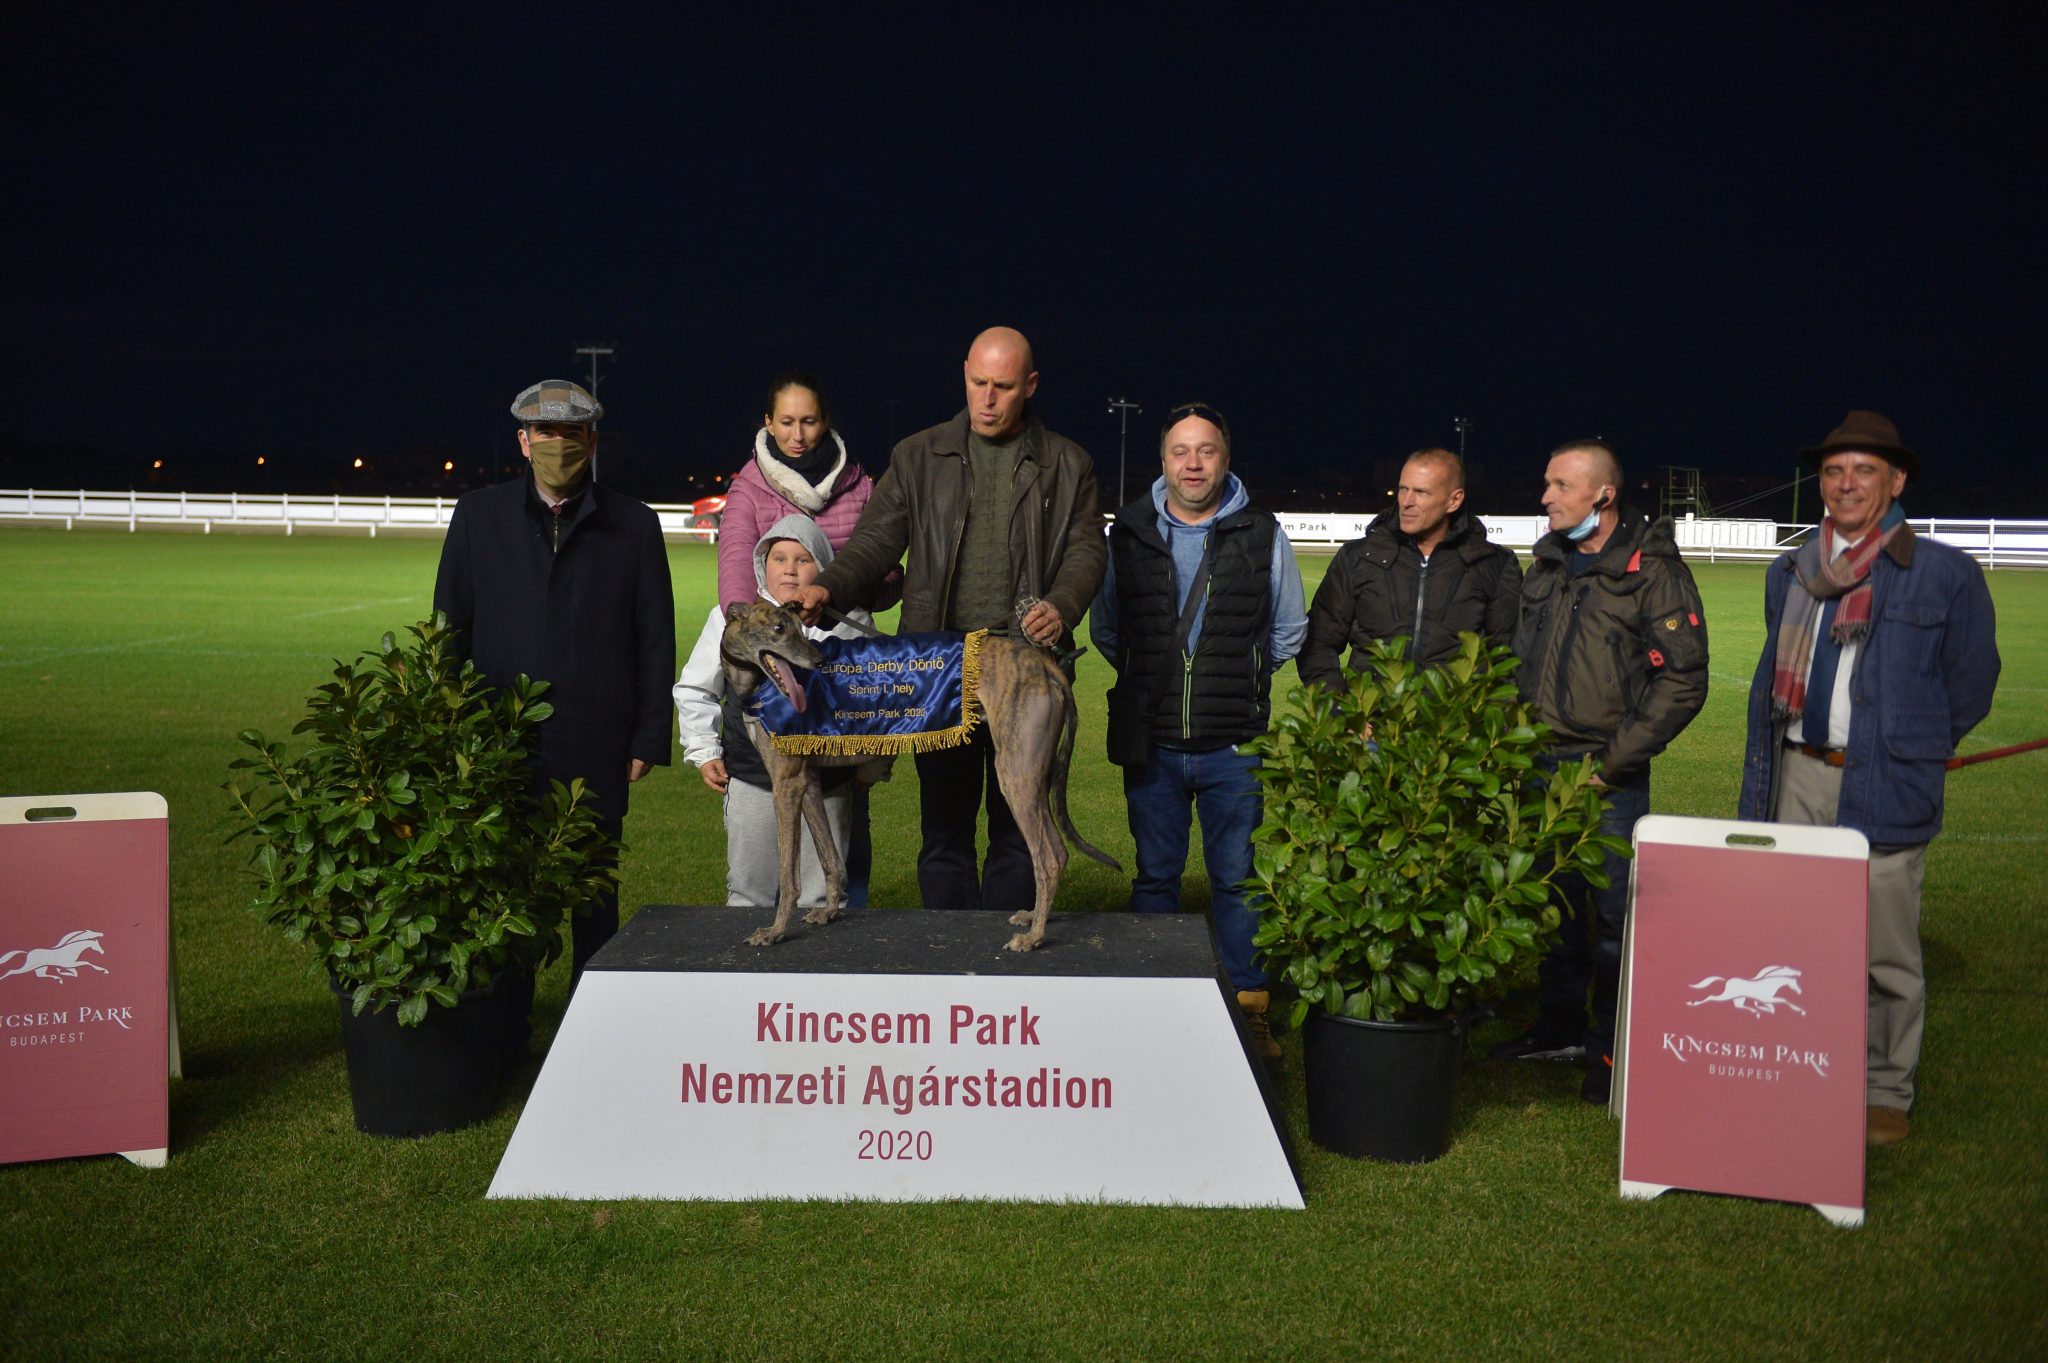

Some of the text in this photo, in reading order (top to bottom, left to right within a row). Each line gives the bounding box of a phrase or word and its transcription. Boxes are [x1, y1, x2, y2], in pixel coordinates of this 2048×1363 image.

[1299, 522, 1327, 531] Park
[867, 659, 903, 674] Derby
[848, 684, 880, 697] Sprint
[893, 683, 915, 696] hely
[834, 709, 875, 720] Kincsem
[878, 708, 901, 719] Park
[756, 1002, 1041, 1046] Kincsem Park
[10, 1031, 85, 1047] BUDAPEST
[1709, 1063, 1782, 1082] BUDAPEST
[681, 1063, 1113, 1115] Nemzeti Agárstadion
[857, 1129, 933, 1161] 2020
